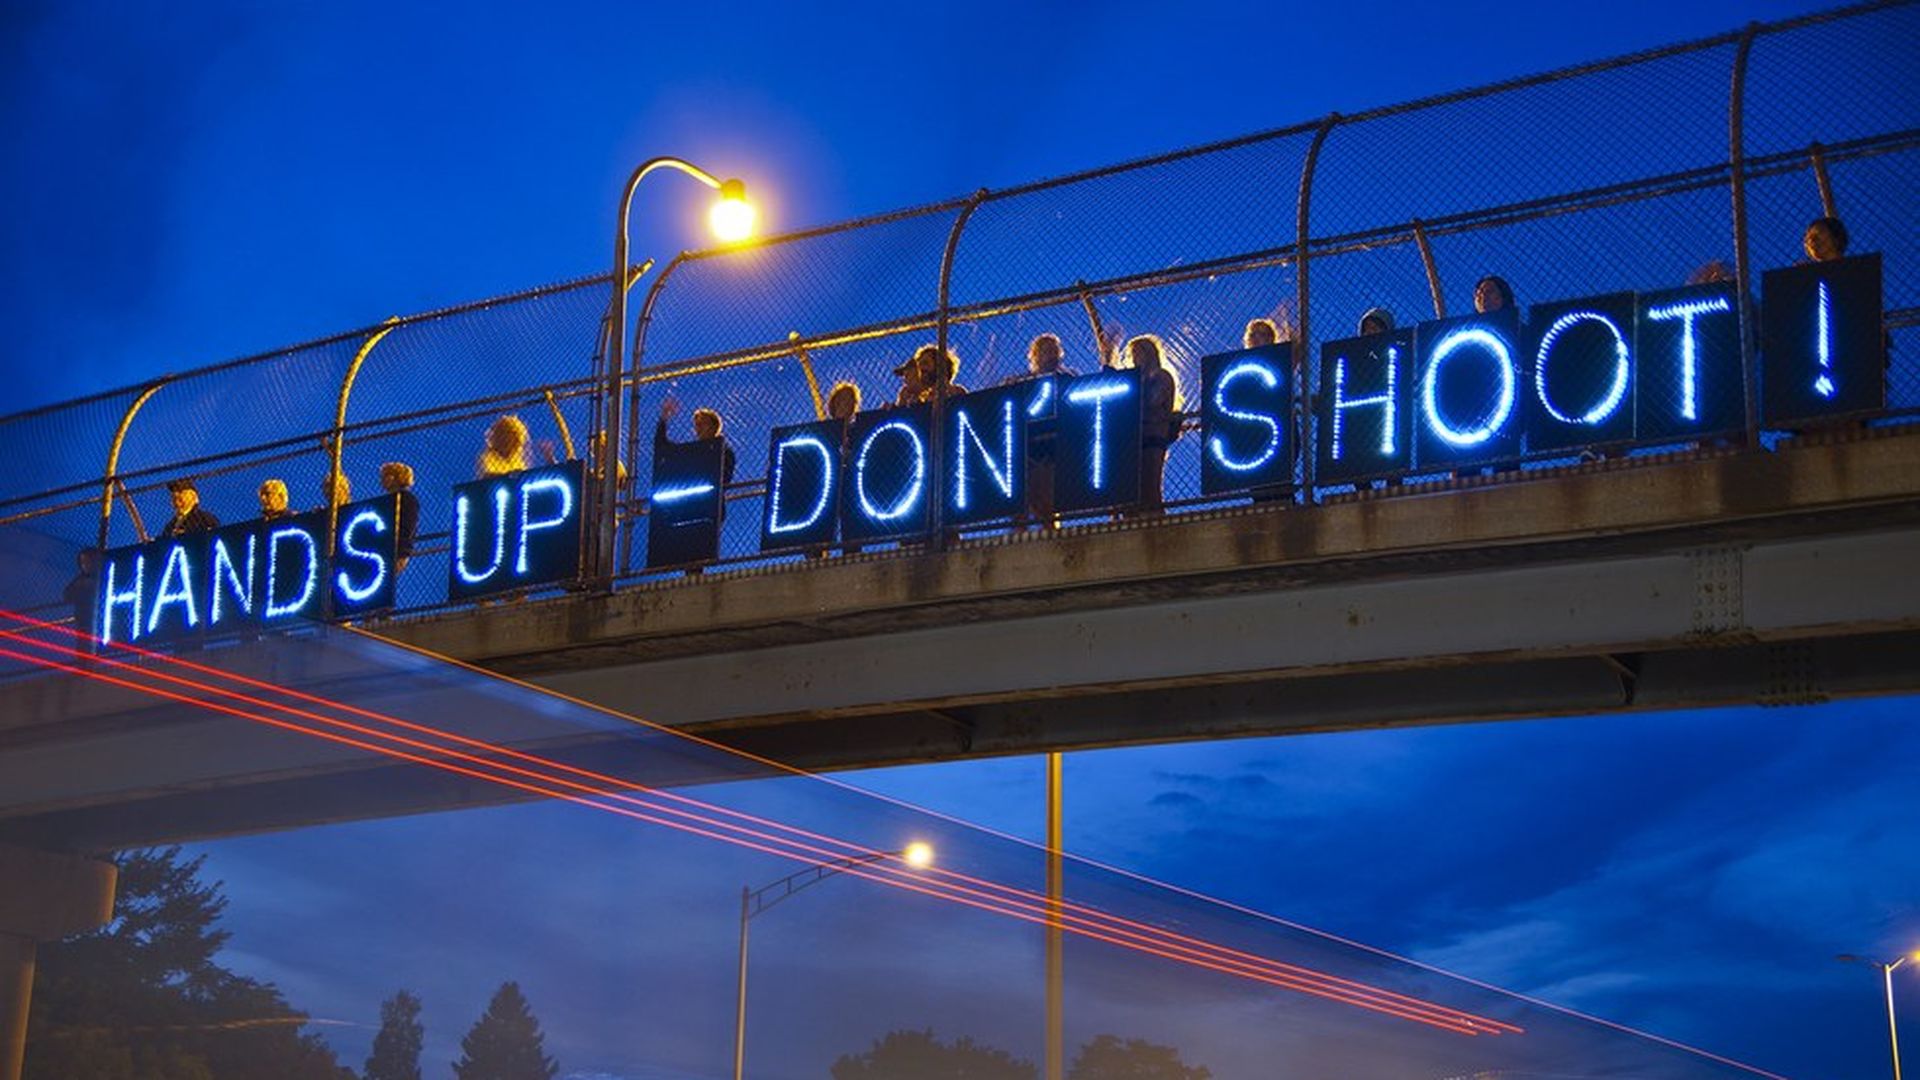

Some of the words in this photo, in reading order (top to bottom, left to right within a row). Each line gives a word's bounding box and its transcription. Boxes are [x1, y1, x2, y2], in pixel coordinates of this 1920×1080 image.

[101, 509, 387, 646] HANDS
[454, 476, 573, 584] UP
[767, 381, 1131, 534] DON'T
